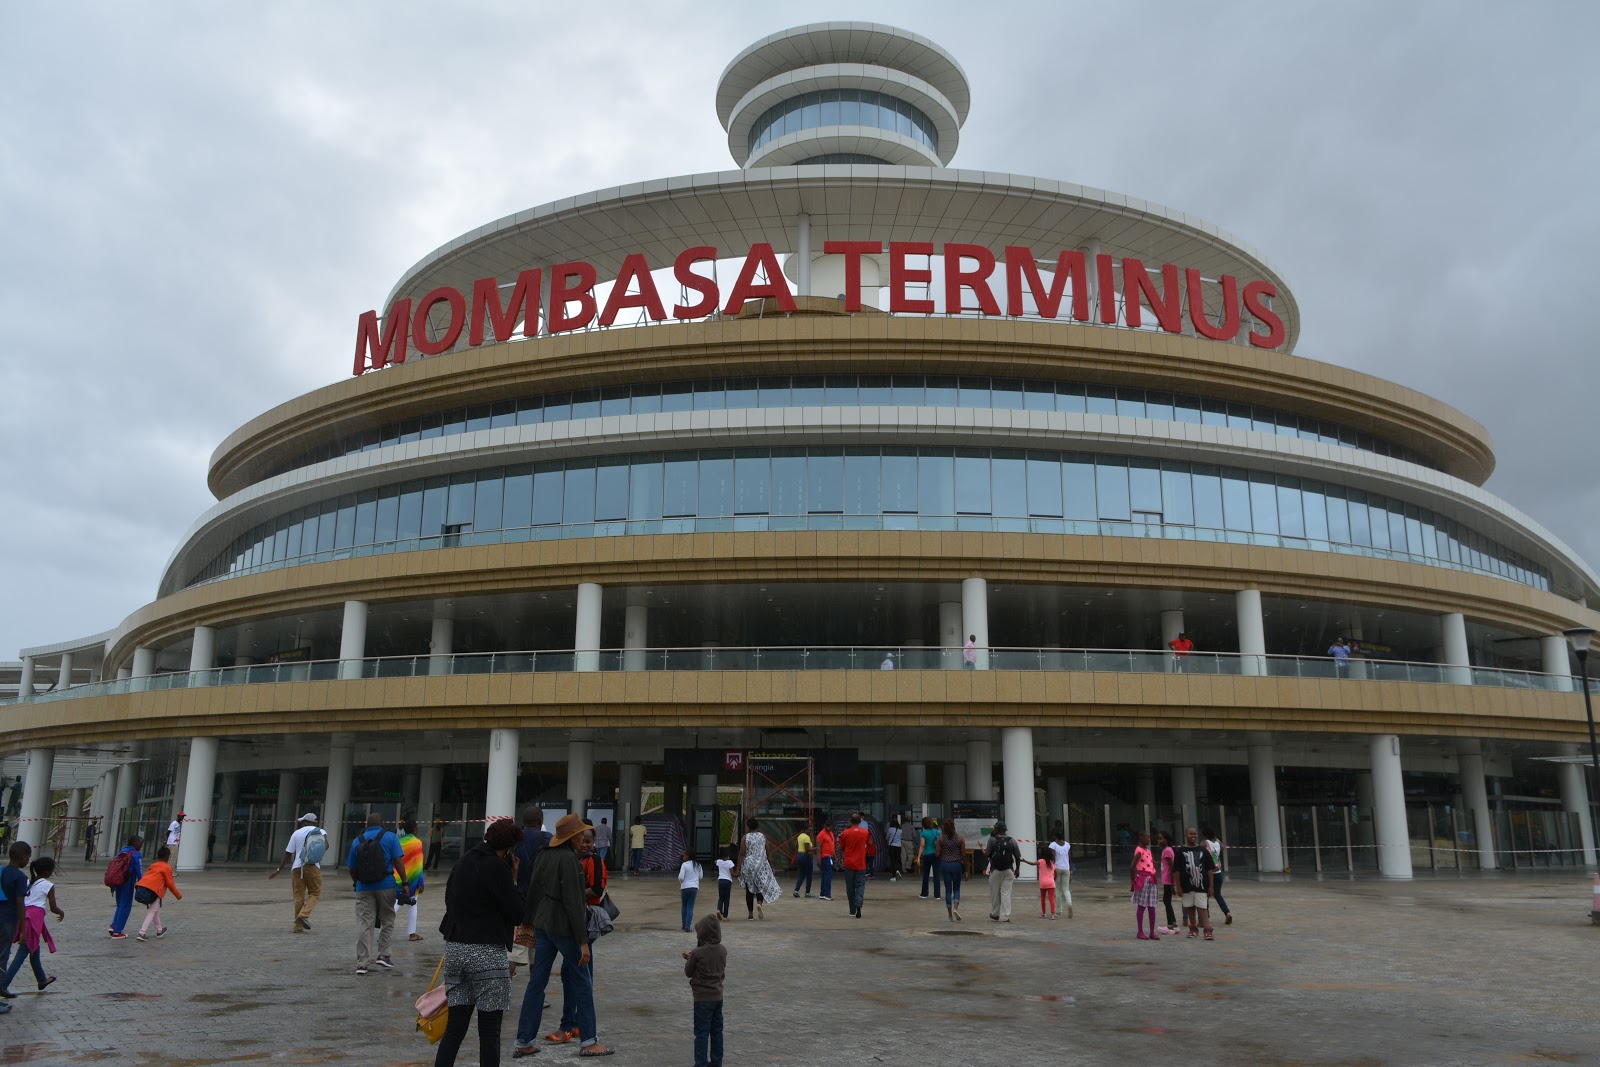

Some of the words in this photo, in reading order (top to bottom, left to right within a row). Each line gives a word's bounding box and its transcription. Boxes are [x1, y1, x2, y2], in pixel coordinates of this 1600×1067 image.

[353, 242, 798, 375] MOMBASA
[823, 241, 1286, 349] TERMINUS
[748, 751, 797, 759] Entrance
